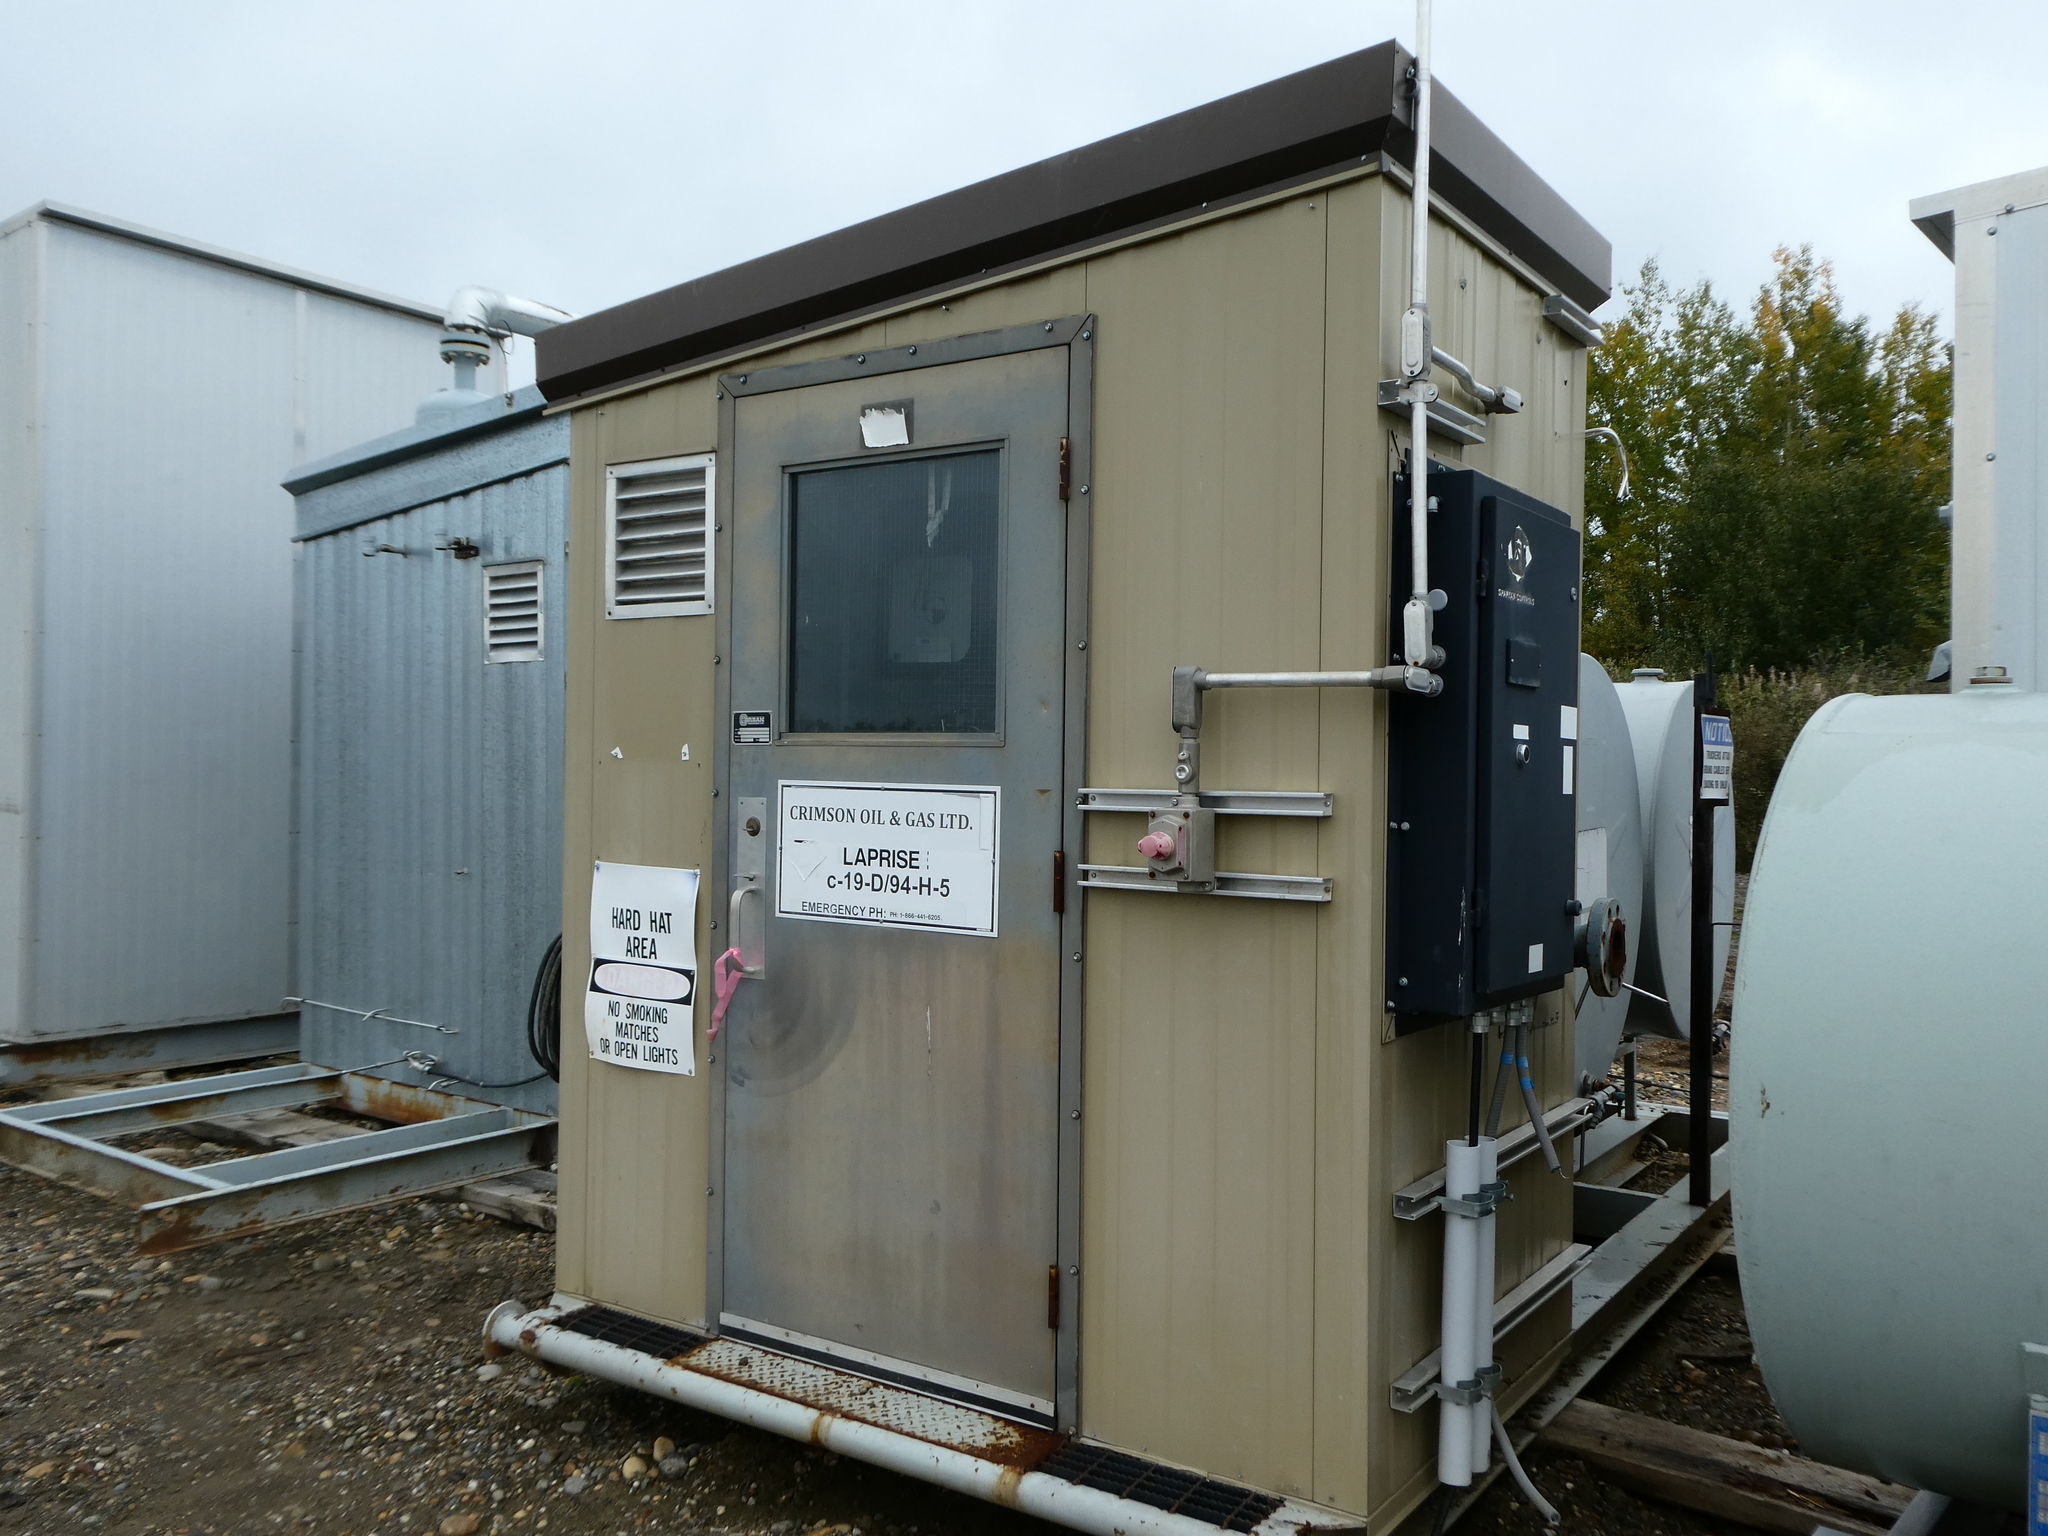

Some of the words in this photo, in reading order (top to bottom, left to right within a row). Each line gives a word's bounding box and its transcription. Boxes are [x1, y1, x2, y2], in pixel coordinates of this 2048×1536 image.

[1706, 722, 1732, 742] NOTIC
[790, 805, 856, 824] CRIMSON
[860, 808, 886, 826] OIL
[889, 810, 902, 827] &
[905, 811, 935, 828] GAS
[939, 813, 973, 831] LTD.
[843, 846, 920, 870] LAPRISE
[827, 871, 951, 898] c-19-D/94-H-5
[611, 906, 641, 931] HARD
[649, 910, 673, 934] HAT
[801, 901, 867, 917] EMERGENCY
[869, 906, 887, 919] PH:
[625, 936, 658, 960] AREA
[607, 1000, 621, 1018] NO
[625, 1002, 668, 1025] SMOKING
[615, 1020, 659, 1043] MATCHES
[599, 1037, 611, 1055] OR
[614, 1040, 638, 1060] OPEN
[643, 1045, 678, 1065] LIGHTS
